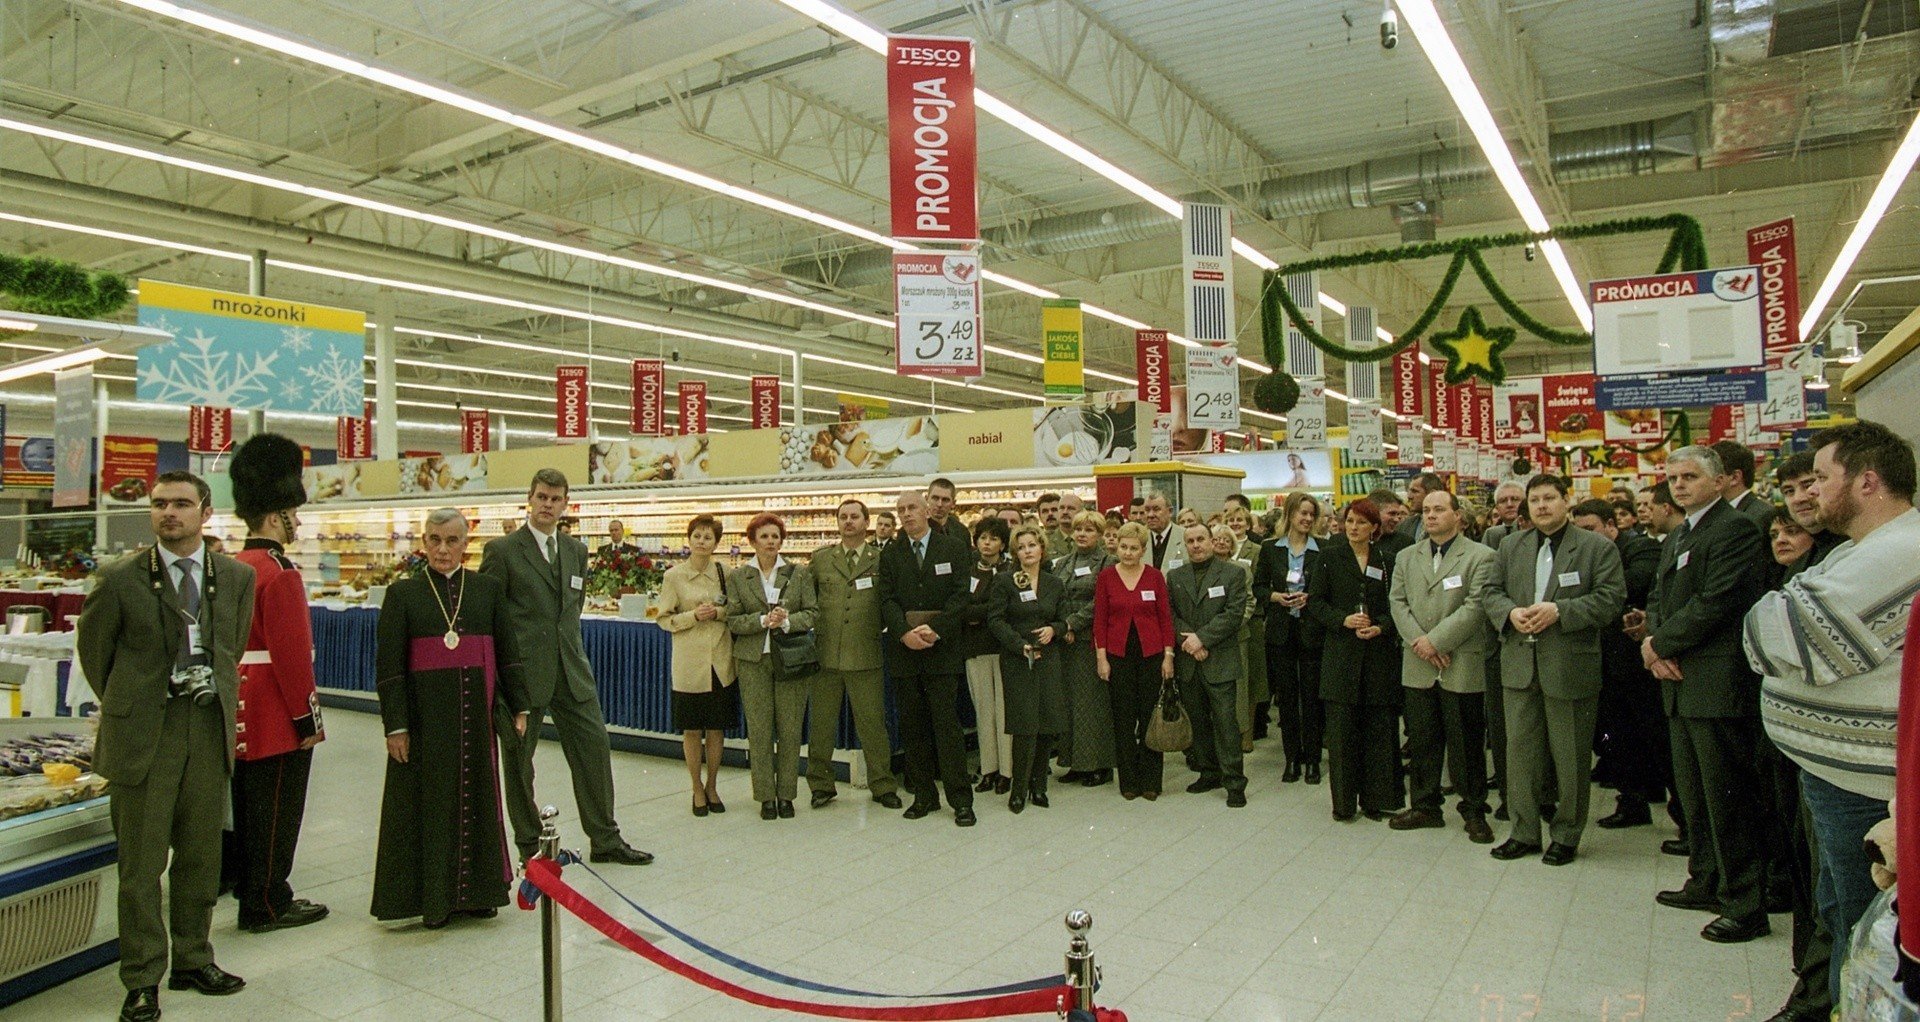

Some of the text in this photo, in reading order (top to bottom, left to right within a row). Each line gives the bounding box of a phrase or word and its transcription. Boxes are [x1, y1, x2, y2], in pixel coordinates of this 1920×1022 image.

[897, 47, 961, 62] TESCO
[912, 77, 956, 231] PROMOCJA
[1753, 224, 1788, 241] TESCO
[897, 263, 938, 273] PROMOCJA
[213, 299, 305, 321] mrożonki
[1596, 280, 1694, 300] PROMOCJA
[1762, 245, 1787, 344] PROMOCJA
[916, 320, 973, 360] 3.49
[952, 347, 974, 360] zł
[1146, 345, 1163, 410] ROMOCJA
[1401, 351, 1415, 413] PROMOCJA
[565, 379, 580, 435] PROMOCJA
[642, 374, 658, 432] PROMOCJA
[687, 393, 700, 434] OMOCJA
[1194, 392, 1232, 417] 2.49
[1220, 409, 1233, 419] zł
[1435, 373, 1448, 427] PROMOCJA
[1461, 387, 1472, 436] PROMOCJA
[968, 431, 1002, 444] nabiał
[1294, 418, 1322, 439] 2.29
[1480, 398, 1490, 444] PROMOCJA
